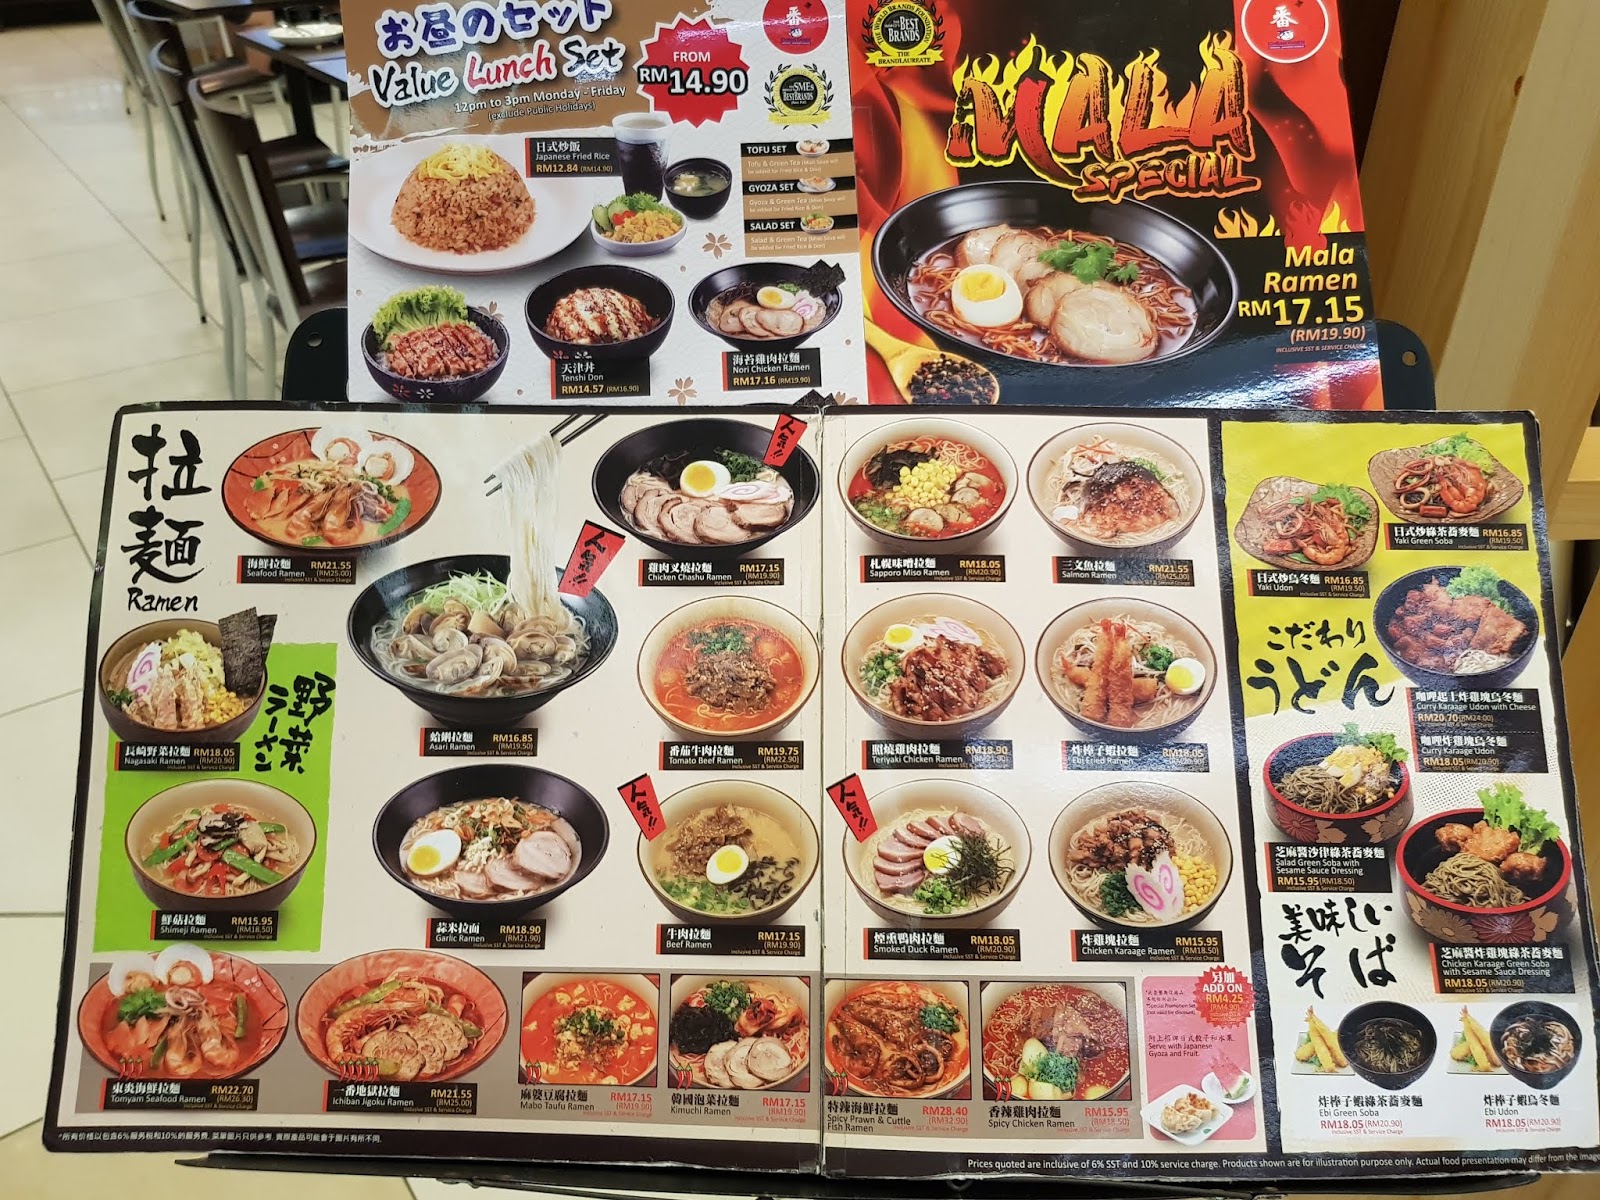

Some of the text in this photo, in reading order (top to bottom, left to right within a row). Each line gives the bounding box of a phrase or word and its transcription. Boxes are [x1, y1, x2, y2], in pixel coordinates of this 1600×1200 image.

[382, 0, 607, 51] お昼のセット
[900, 17, 919, 30] BEST
[889, 28, 920, 42] BRANDS
[673, 51, 711, 62] FROM
[373, 40, 621, 101] Value Lunch Set
[639, 67, 746, 94] RM14.90
[455, 85, 626, 114] 12pm to 3pm Monday Friday
[488, 101, 595, 121] (exclude Public Holidays)
[946, 46, 1255, 169] MALA
[537, 141, 580, 152] 日式炒飯
[747, 146, 770, 154] TOFU
[536, 153, 570, 161] Japanese
[536, 164, 578, 172] RM12.84
[1073, 152, 1261, 203] SPECIAL
[749, 183, 794, 192] GYOZA SET
[750, 222, 778, 230] SALAD
[1285, 243, 1355, 268] Mala
[1264, 272, 1358, 294] Ramen
[1238, 296, 1364, 326] RM17.15
[1290, 326, 1366, 344] (RM19.90)
[562, 374, 585, 382] Tenshi
[733, 376, 810, 385] RM17.16 (RM19.90)
[562, 385, 639, 394] RM14.57 (RM16.90)
[1483, 529, 1522, 537] RM16.85
[1435, 537, 1453, 545] Soba
[311, 561, 351, 570] RM21.55
[739, 564, 779, 572] RM17.15
[959, 560, 1000, 568] RM18.05
[247, 569, 305, 578] Seafood Ramen
[648, 573, 732, 581] Chicken Chashu Ramen
[870, 570, 901, 578] Sapporo
[1324, 576, 1364, 584] RM16.85
[127, 587, 198, 612] Ramen
[1267, 618, 1366, 651] こだわり
[1246, 653, 1395, 715] うどん
[493, 734, 533, 743] RM16.85
[450, 743, 475, 751] Ramen
[758, 747, 799, 756] RM19.75
[193, 748, 235, 757] RM18.05
[125, 757, 186, 766] Nagasaki Ramen
[669, 757, 696, 765] Tomato
[1298, 859, 1321, 867] Green
[1323, 859, 1341, 867] Soba
[1332, 867, 1363, 876] Dressing
[1278, 876, 1355, 886] RM15.95 (RM18.50)
[231, 917, 273, 926] RM15.95
[1278, 897, 1393, 944] 美味しい
[160, 926, 217, 935] Shimeji Ramen
[758, 932, 800, 941] RM17.15
[970, 936, 1015, 945] RM18.05
[666, 940, 712, 949] Beef Ramen
[1175, 937, 1218, 947] RM15.95
[874, 945, 958, 954] Smoked Duck Ramen
[1082, 947, 1175, 956] Chicken Karaage Ramen
[1281, 933, 1397, 999] そば
[1442, 960, 1550, 969] Chicken Karaage Green Soba
[1443, 968, 1550, 977] with Sesame Sauce Dressing
[1445, 979, 1488, 988] RM18.05
[1203, 984, 1242, 993] ADD ON
[1206, 994, 1243, 1003] RM4.25
[211, 1085, 254, 1095] RM22.70
[431, 1089, 472, 1098] RM21.55
[110, 1094, 206, 1105] Tomyam Seafood Ramen
[332, 1097, 414, 1107] Ichiban Jigoku Ramen
[922, 1106, 968, 1116] RM28.40
[1084, 1107, 1129, 1117] RM15.95
[1319, 1109, 1379, 1117] Ebi Green Soba
[827, 1114, 911, 1125] Spicy Prawn Cuttle
[989, 1119, 1075, 1128] Spicy Chicken Ramen
[1485, 1119, 1526, 1127] RM18.05
[845, 1124, 874, 1132] Ramen
[1321, 1120, 1364, 1129] RM18.05
[968, 1156, 1509, 1170] Prices quoted inclusive service charge. Products illustration presentation
